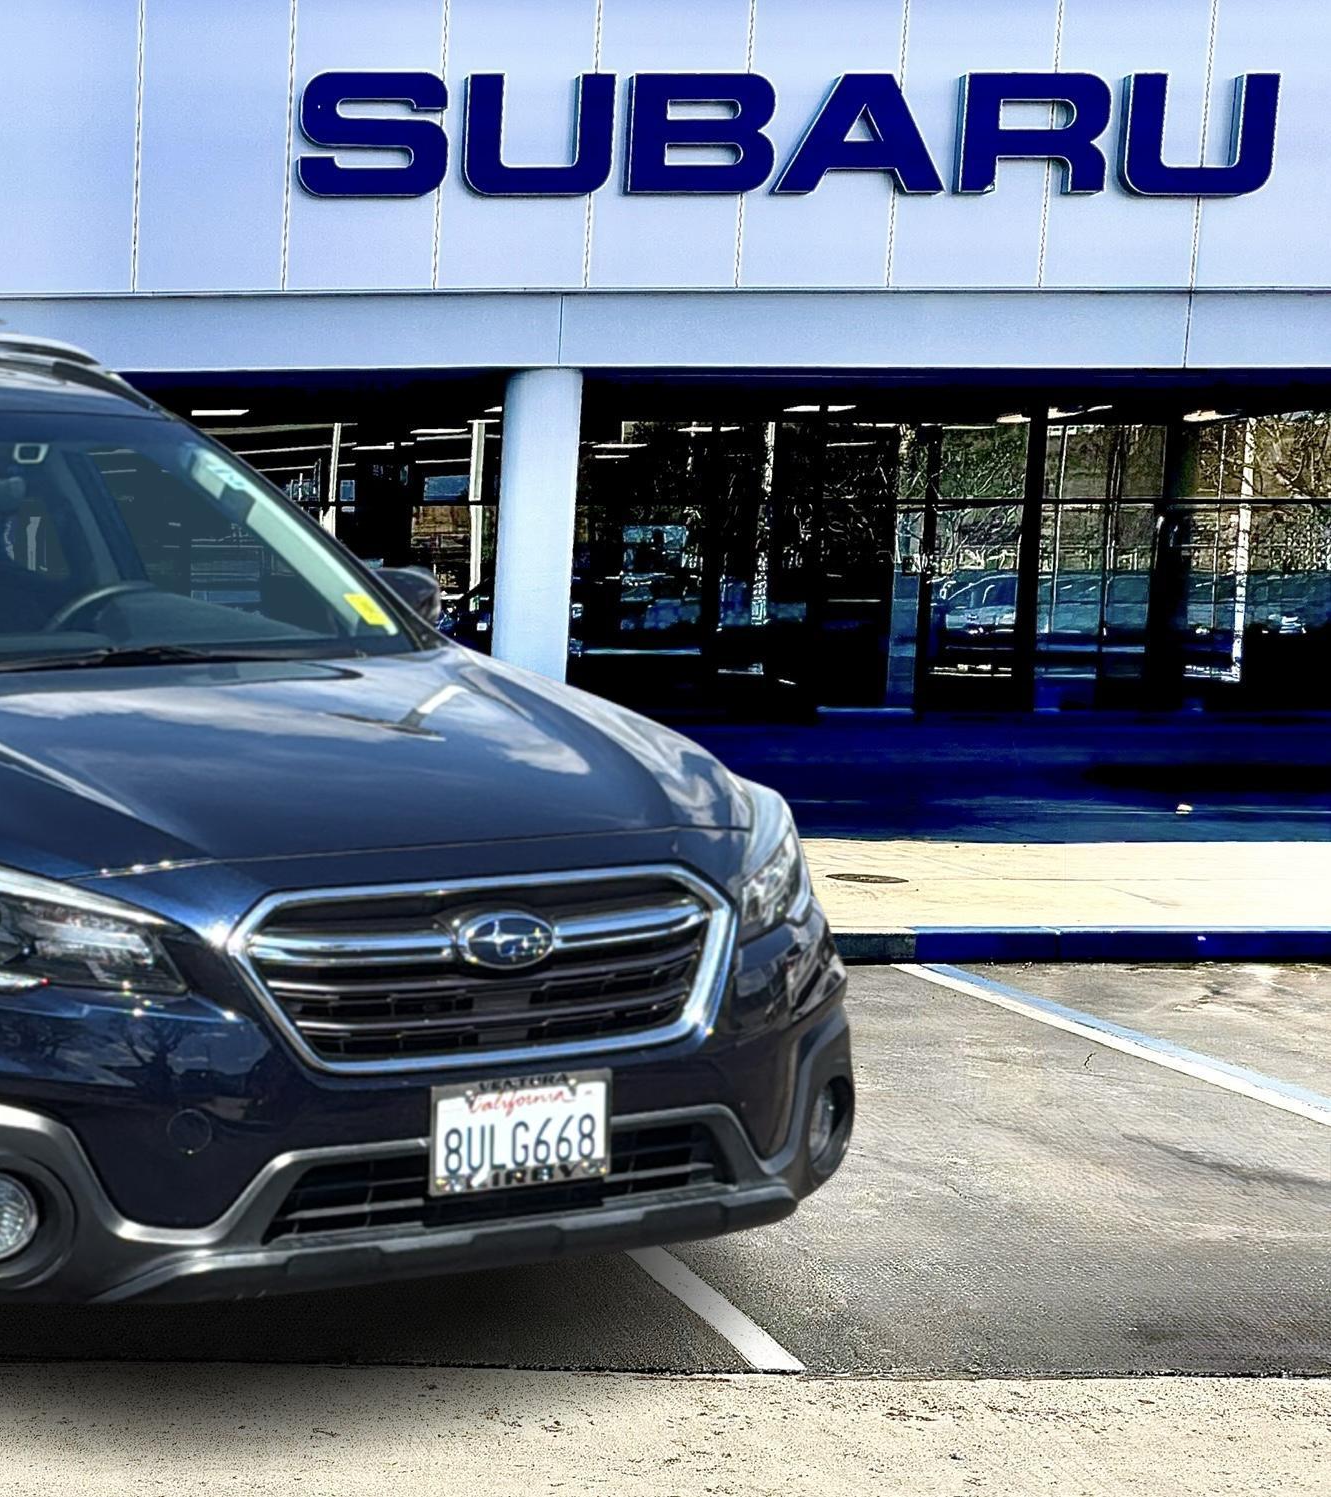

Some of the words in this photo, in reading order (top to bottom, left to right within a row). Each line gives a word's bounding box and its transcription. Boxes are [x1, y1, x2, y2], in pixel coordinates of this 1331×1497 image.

[296, 71, 1281, 197] SUBARU
[468, 1088, 574, 1117] California
[479, 1073, 570, 1091] VENTURA
[444, 1113, 596, 1175] 8ULG668
